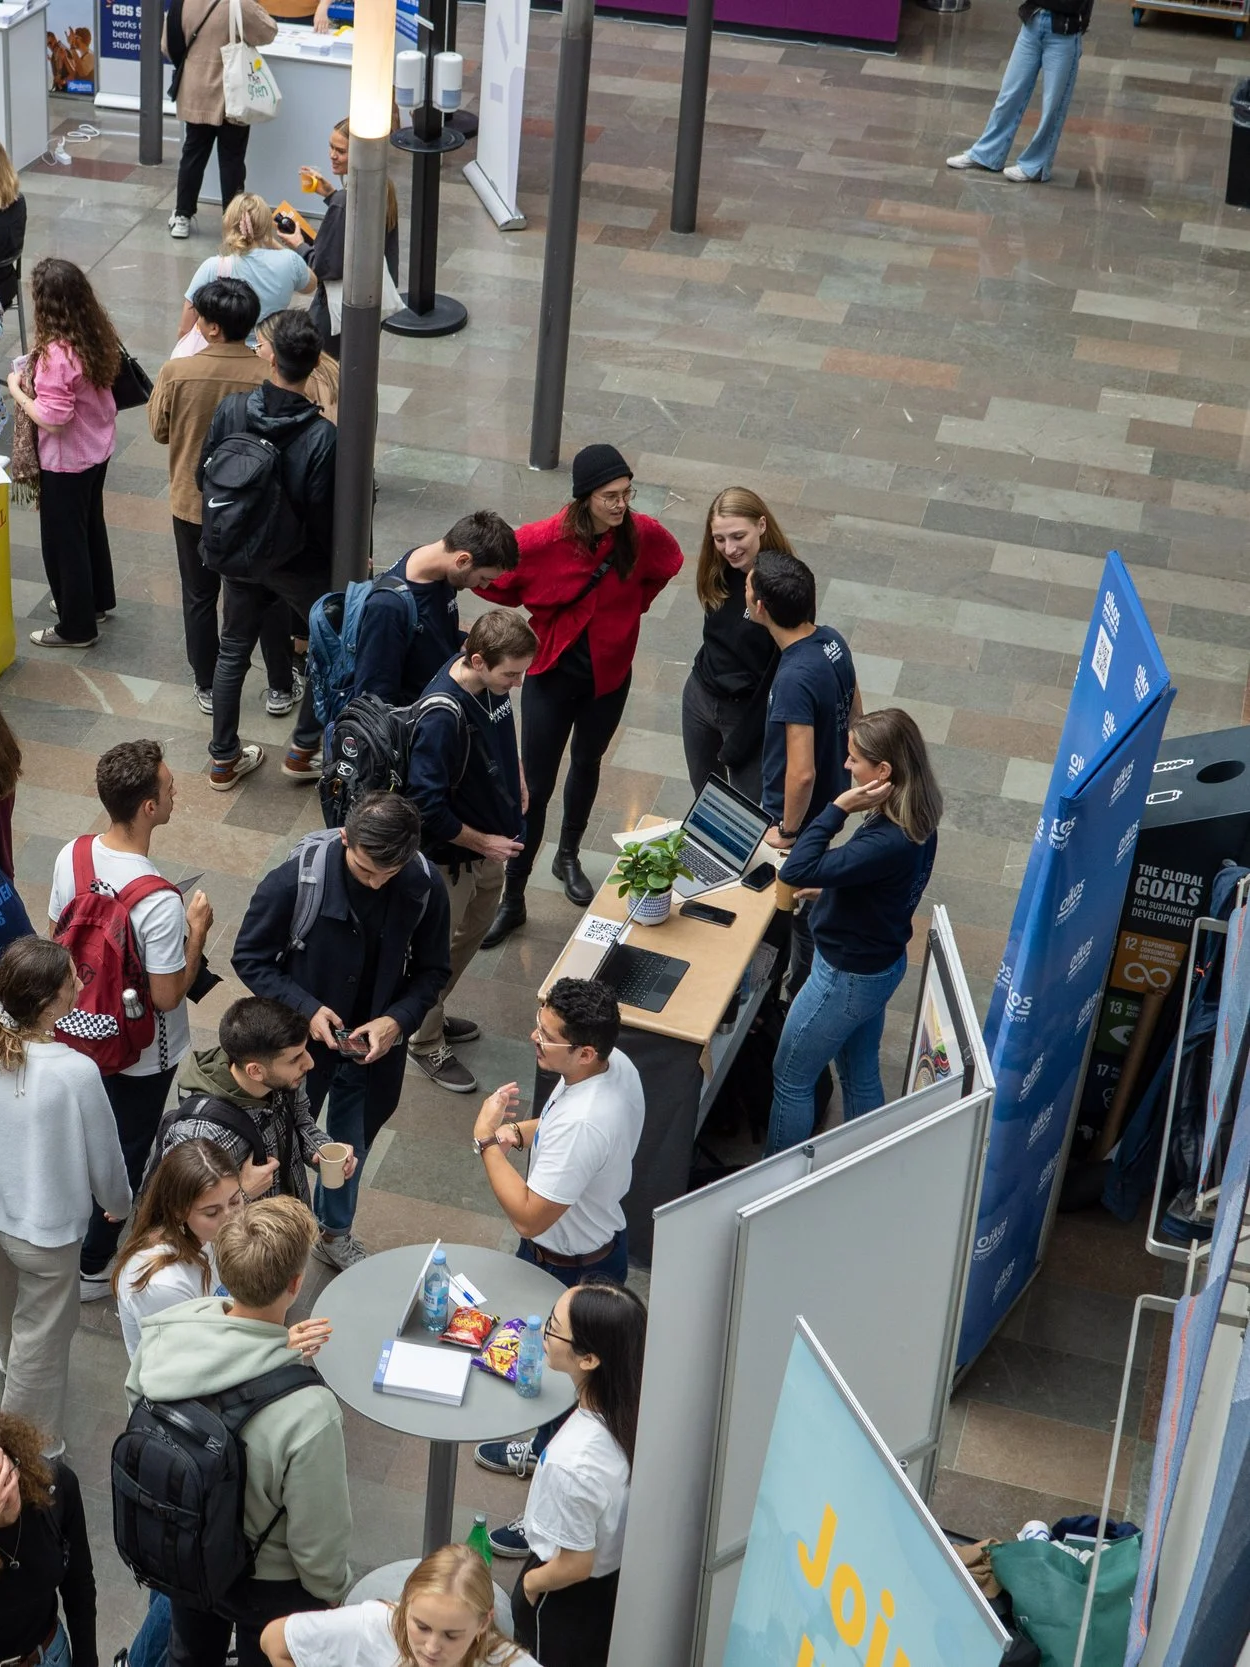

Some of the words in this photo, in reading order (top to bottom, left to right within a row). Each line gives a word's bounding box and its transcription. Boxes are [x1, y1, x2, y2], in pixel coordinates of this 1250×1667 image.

[112, 4, 134, 17] CBS
[112, 20, 137, 29] works
[112, 30, 138, 40] better
[112, 41, 141, 51] studen
[1139, 863, 1160, 878] THE
[1161, 868, 1204, 887] GLOBAL
[1059, 878, 1086, 912] oikos
[1134, 876, 1201, 906] GOALS
[1133, 898, 1147, 907] FOR
[1149, 900, 1195, 917] SUSTAINABLE
[1131, 907, 1192, 928] DEVELOPMENT
[1125, 936, 1137, 951] 12
[1110, 1000, 1123, 1015] 13
[1096, 1064, 1109, 1077] 17
[797, 1502, 911, 1667] Joi
